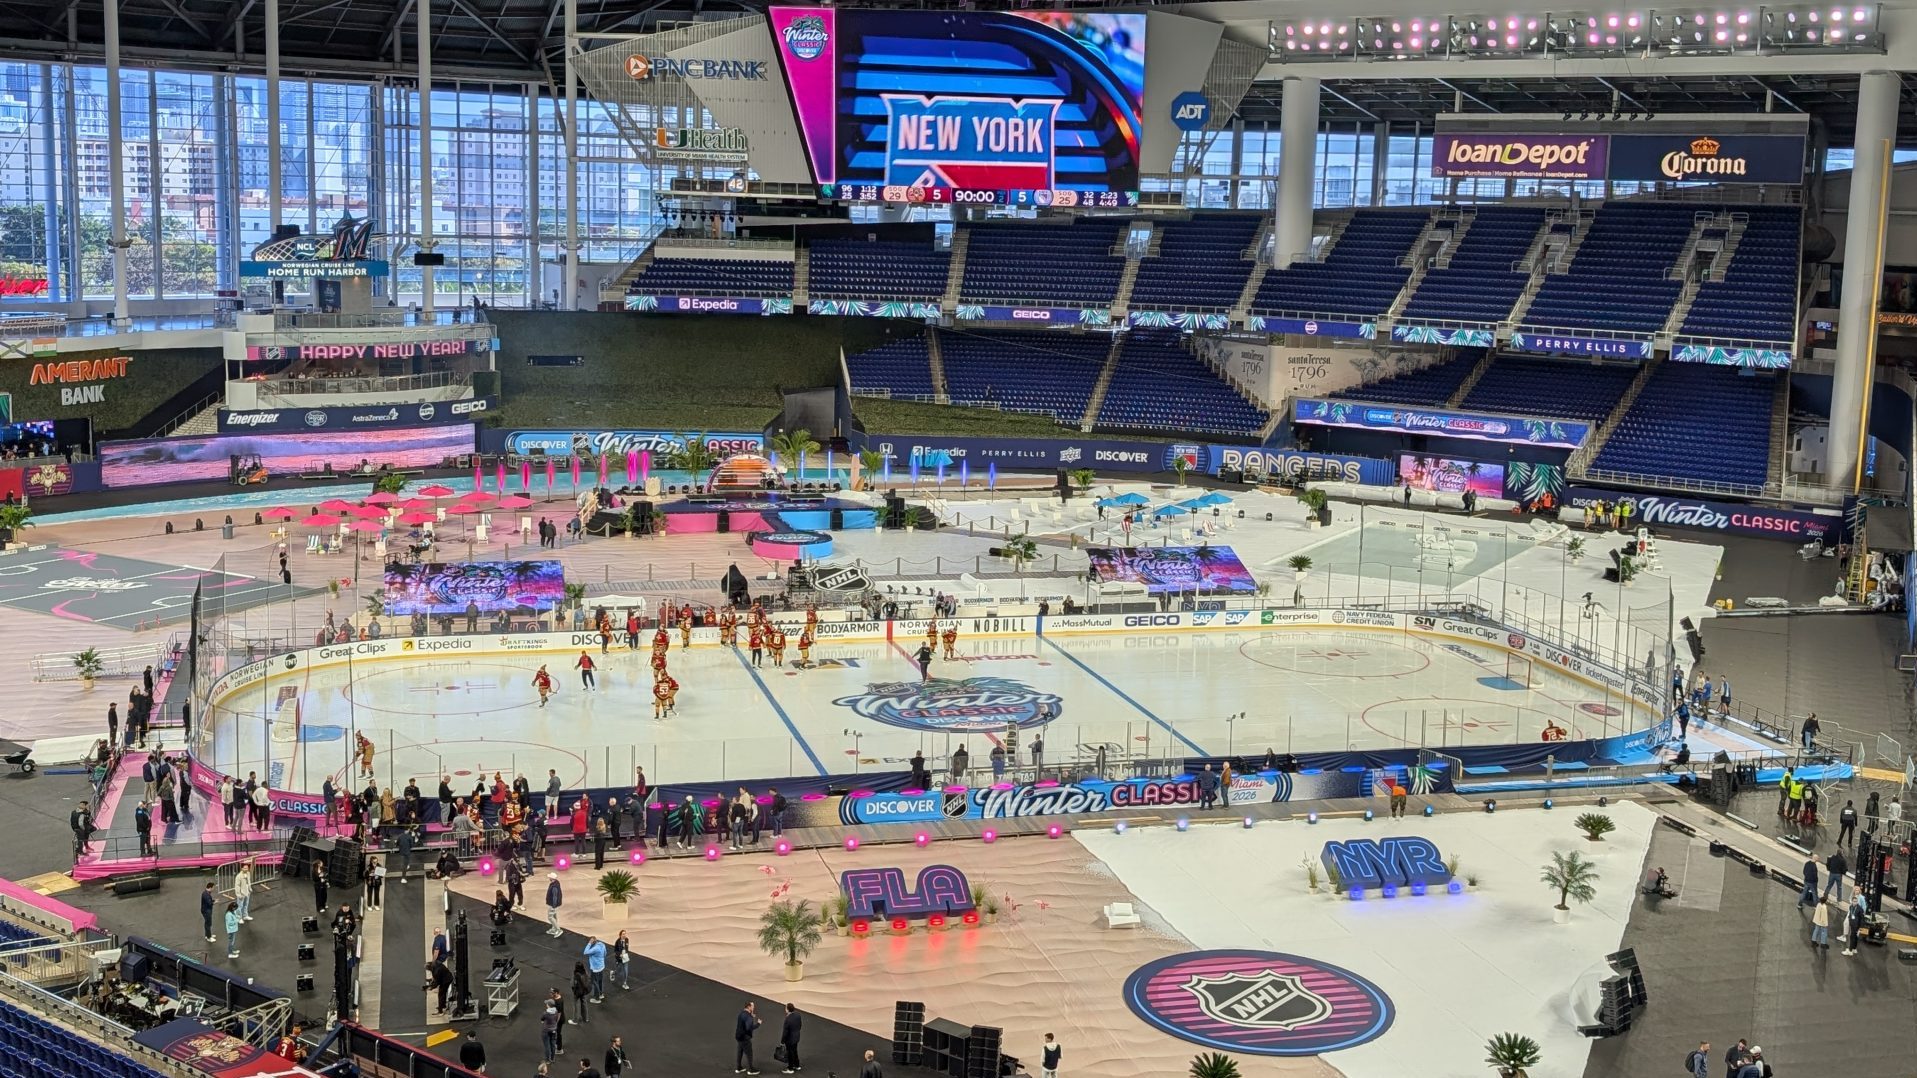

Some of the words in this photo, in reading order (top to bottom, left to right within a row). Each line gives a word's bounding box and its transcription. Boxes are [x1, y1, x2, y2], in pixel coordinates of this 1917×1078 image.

[782, 27, 829, 43] Winter
[652, 58, 698, 78] PNC
[702, 59, 765, 80] BANK
[1176, 104, 1206, 120] ADT
[898, 114, 962, 151] NEW
[972, 116, 1044, 153] YORK
[1448, 140, 1590, 169] loanDepot
[1661, 151, 1746, 180] Corona
[728, 178, 744, 190] 42
[933, 190, 942, 200] 5
[956, 191, 994, 202] 90:00
[1018, 192, 1026, 202] 5
[296, 242, 314, 250] NCL
[303, 268, 324, 276] RUN
[328, 268, 367, 276] HARBOR
[692, 298, 738, 311] Expedia
[1013, 310, 1050, 319] GEICO
[300, 345, 366, 359] HAPPY
[374, 344, 415, 358] NEW
[420, 340, 466, 356] YEAR!
[1536, 339, 1580, 350] PERRY
[1586, 343, 1626, 352] ELLIS
[30, 357, 129, 385] AMERANT
[1242, 362, 1261, 377] 1796
[1291, 366, 1326, 382] 1796
[61, 385, 105, 406] BANK
[451, 400, 487, 414] GEICO
[226, 412, 279, 426] Energizer
[352, 414, 390, 422] AstraZeneca
[1404, 412, 1447, 428] Winter
[1448, 419, 1484, 429] CLASSIC
[521, 440, 566, 449] DISCOVER
[594, 433, 683, 454] Winter
[1096, 450, 1148, 462] DISCOVER
[1431, 468, 1468, 483] Winter
[1638, 497, 1729, 529] Winter
[1731, 514, 1800, 532] CLASSIC
[1803, 521, 1829, 531] Miami
[824, 569, 858, 588] NHL
[900, 620, 962, 628] NORWGIAN
[1062, 618, 1112, 627] MassMutual
[1124, 615, 1180, 626] GEICO
[1193, 615, 1212, 626] SAP
[1226, 614, 1244, 624] SAP
[1265, 612, 1318, 624] enterprise
[1414, 616, 1436, 627] SN
[817, 622, 880, 634] BODYARMOR
[974, 619, 1026, 633] NOBULL
[1443, 622, 1473, 634] Great
[1476, 628, 1498, 640] Clips
[319, 644, 353, 659] Great
[356, 643, 386, 656] Clips
[418, 639, 472, 651] Expedia
[1546, 649, 1582, 672] DISCOVER
[230, 658, 274, 681] NORWEGIAN
[234, 676, 252, 688] CRUISE
[1586, 666, 1625, 689] ticketmaster
[660, 685, 669, 695] 53
[1631, 683, 1659, 706] Energizer
[832, 694, 1063, 717] Winter
[900, 705, 1032, 718] CLASSIC
[926, 714, 1018, 724] DISCOVER
[1230, 778, 1265, 790] Miami
[866, 802, 935, 815] DISCOVER
[946, 797, 966, 814] NHL
[975, 785, 1106, 818] Winter
[1111, 780, 1200, 806] CLASSI
[1232, 791, 1256, 801] 2026
[1322, 836, 1450, 888] NYR
[841, 864, 976, 920] FLA
[1230, 984, 1289, 1019] NHL
[280, 1044, 288, 1057] 3
